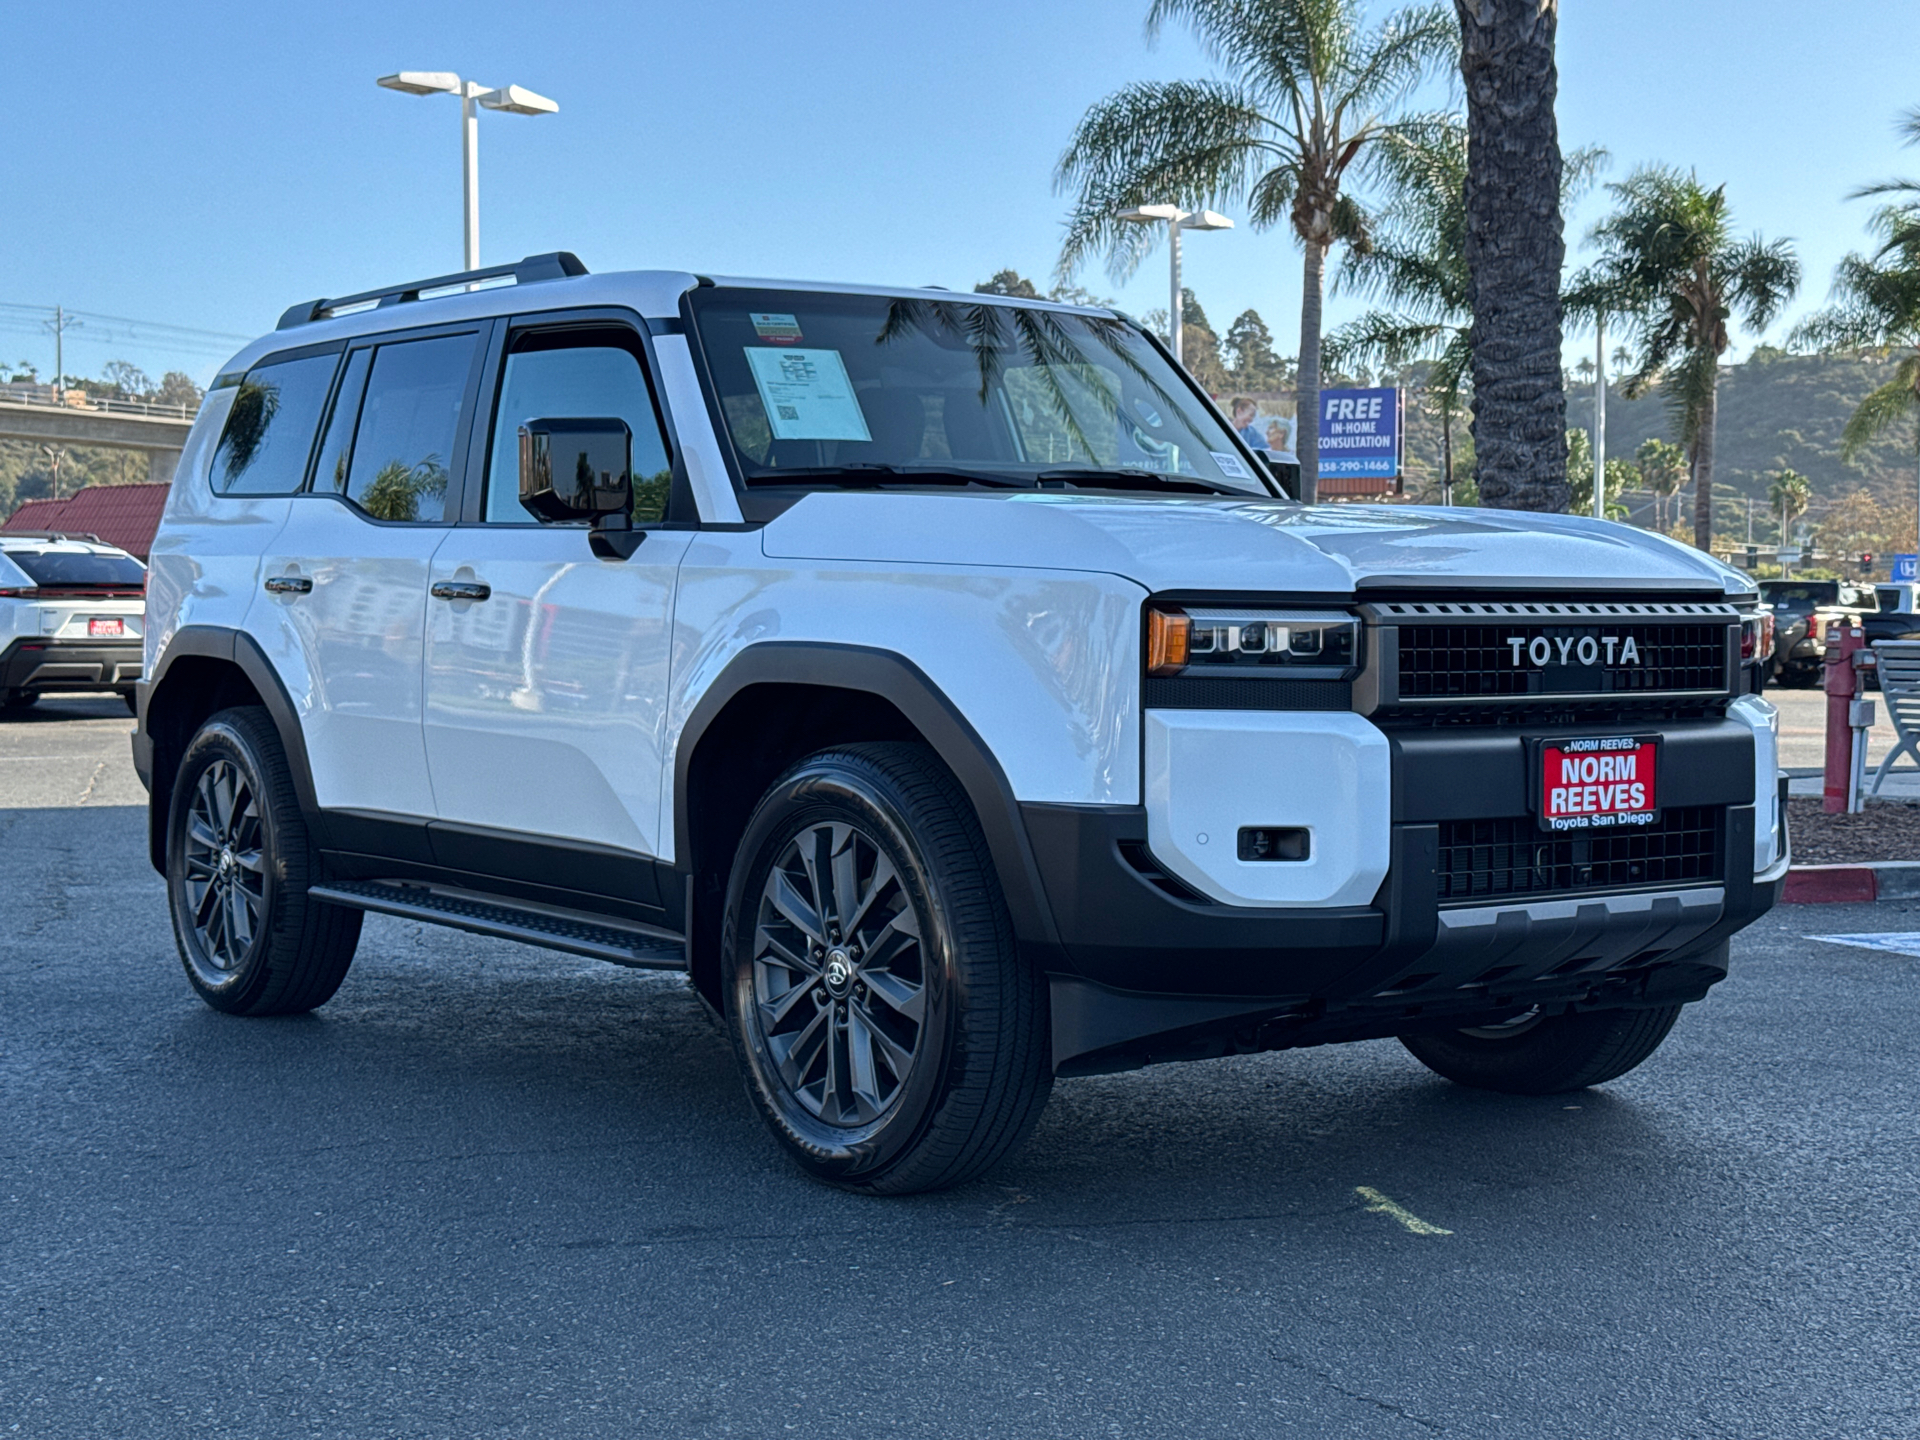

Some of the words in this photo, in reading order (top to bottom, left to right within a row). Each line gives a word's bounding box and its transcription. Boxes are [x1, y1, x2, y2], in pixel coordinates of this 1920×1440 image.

[1325, 397, 1382, 420] FREE
[1331, 421, 1376, 435] IN-HOME
[1318, 435, 1391, 449] CONSULTATION
[1507, 636, 1640, 666] TOYOTA
[1570, 740, 1599, 752] NORM
[1600, 738, 1634, 750] REEVES
[1561, 755, 1636, 784] NORM
[1550, 782, 1645, 813] REEVES
[1549, 816, 1588, 831] Toyota
[1591, 814, 1615, 826] San
[1618, 812, 1653, 826] Diego
